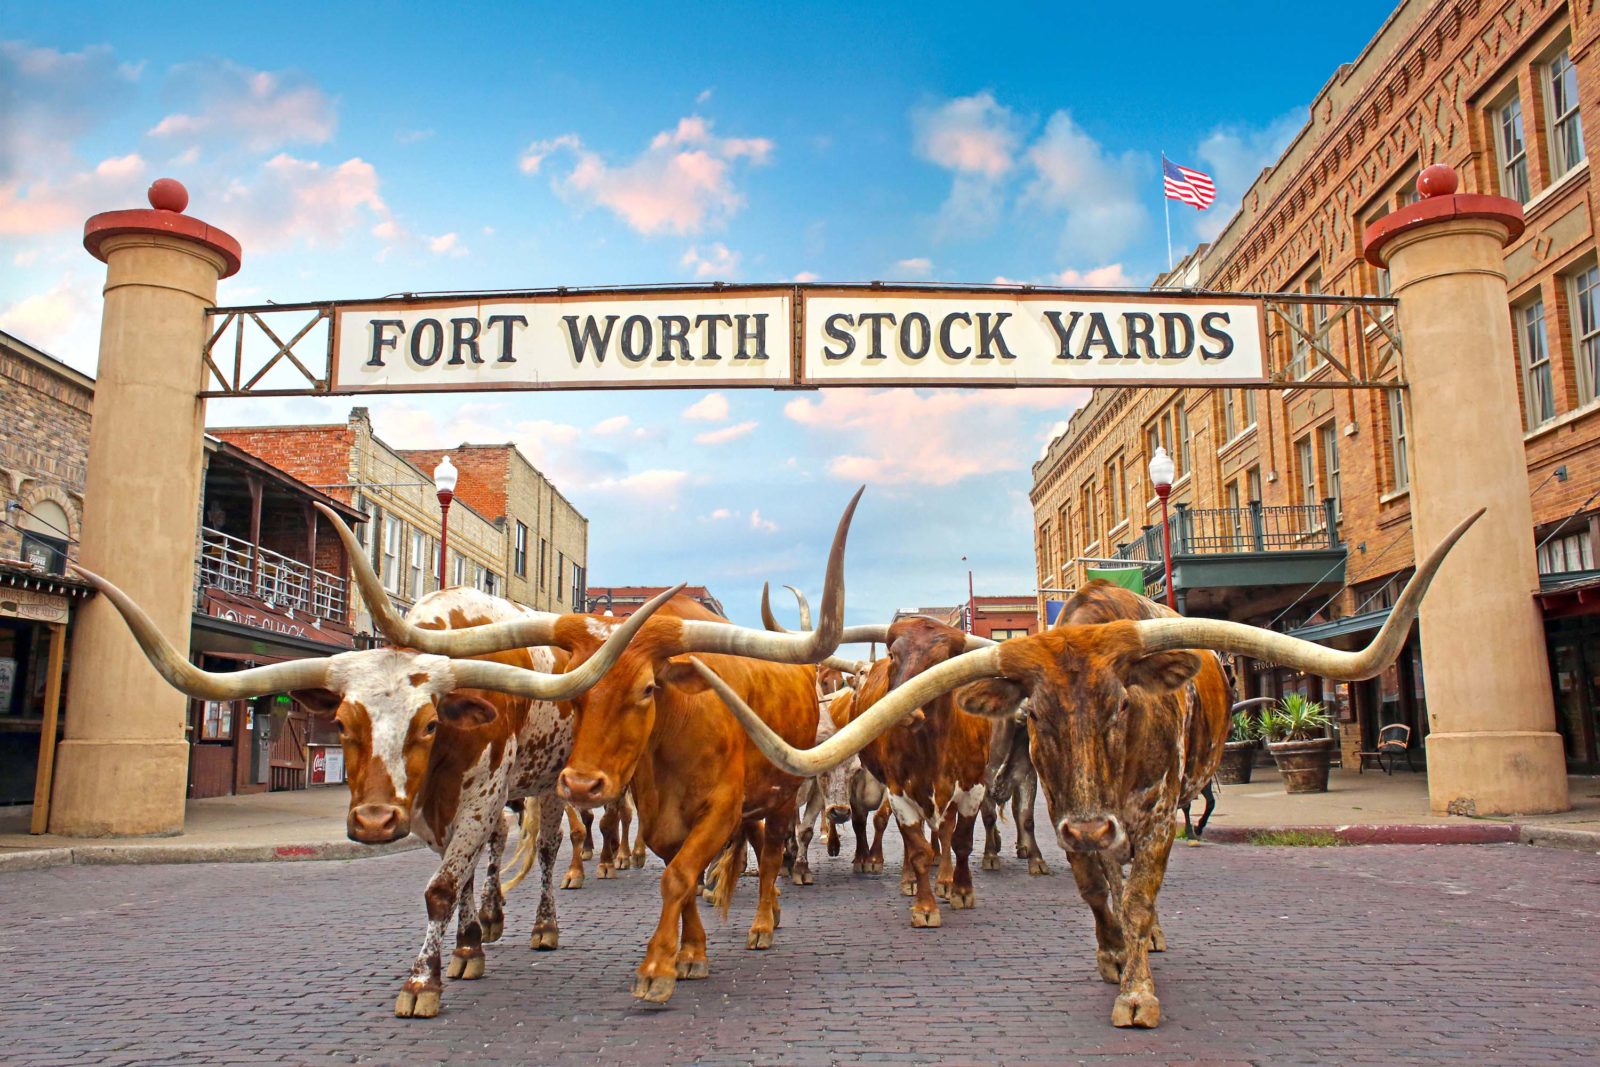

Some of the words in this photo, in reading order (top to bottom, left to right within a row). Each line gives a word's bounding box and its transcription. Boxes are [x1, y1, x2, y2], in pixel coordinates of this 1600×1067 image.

[365, 313, 529, 368] FORT
[562, 312, 771, 365] WORTH
[822, 311, 1017, 361] STOCK
[1042, 310, 1235, 361] YARDS
[1144, 581, 1164, 599] OTEL
